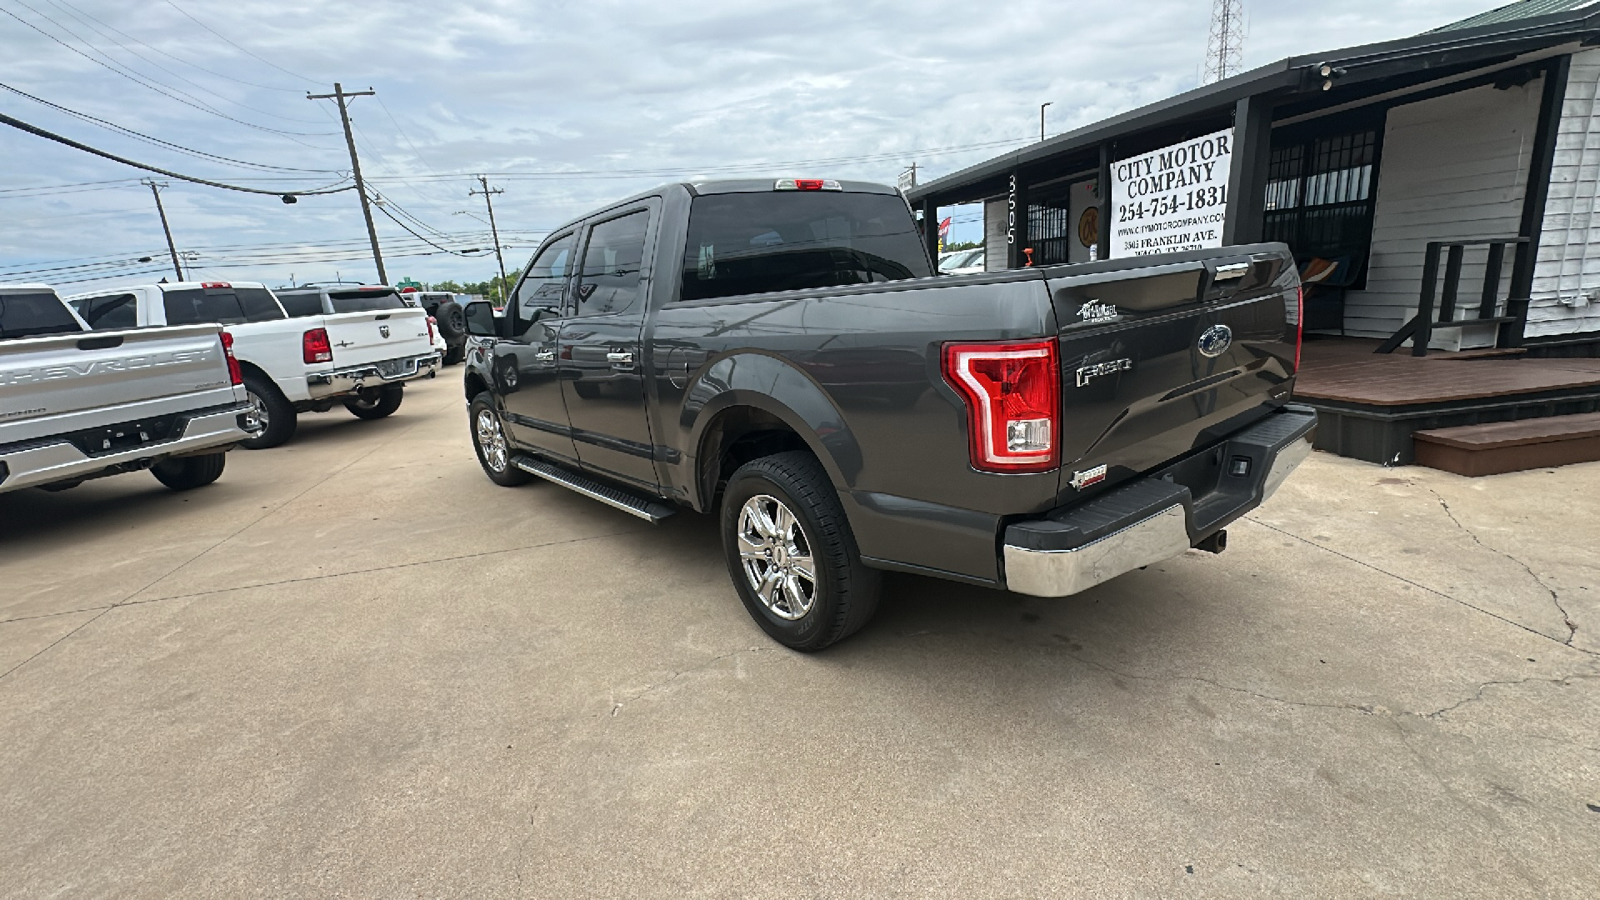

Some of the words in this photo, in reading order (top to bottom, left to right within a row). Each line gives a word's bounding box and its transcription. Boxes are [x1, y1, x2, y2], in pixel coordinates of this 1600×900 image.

[1117, 156, 1154, 182] CITY
[1158, 135, 1230, 172] MOTOR
[1127, 160, 1216, 199] COMPANY
[1008, 175, 1016, 245] 3505
[1119, 184, 1227, 223] 254-754-1831
[1141, 232, 1191, 249] FRANKLIN
[1192, 229, 1218, 243] AVE.
[0, 349, 212, 387] HEVROLET
